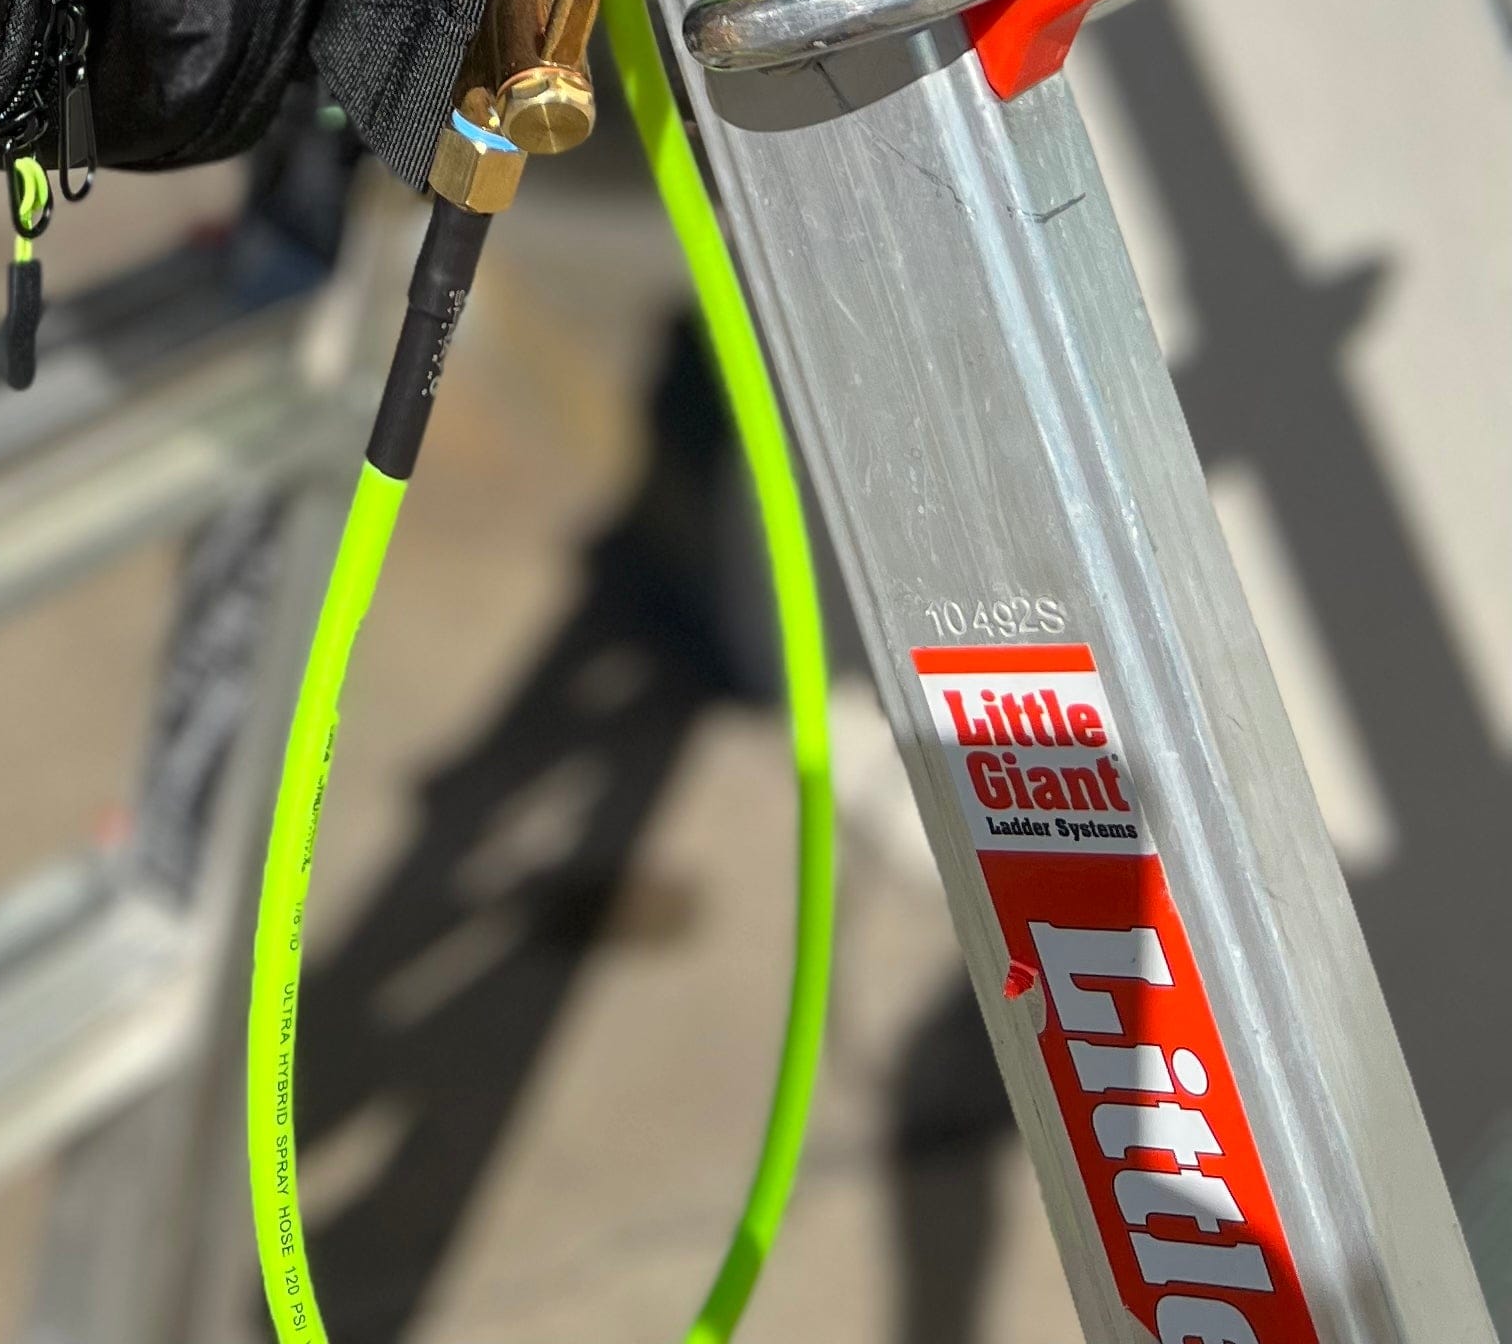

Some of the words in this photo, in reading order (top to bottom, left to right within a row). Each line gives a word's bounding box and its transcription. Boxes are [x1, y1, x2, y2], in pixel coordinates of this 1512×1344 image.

[942, 688, 1109, 748] Little
[965, 750, 1132, 812] Giant
[986, 816, 1053, 838] Ladder
[1055, 817, 1138, 842] Systems
[280, 981, 295, 1045] ULTRA
[276, 1052, 289, 1126] HYBRID
[276, 1134, 289, 1194] SPRAY
[278, 1205, 295, 1258] HOSE
[284, 1266, 300, 1296] 120
[290, 1302, 308, 1332] PSI
